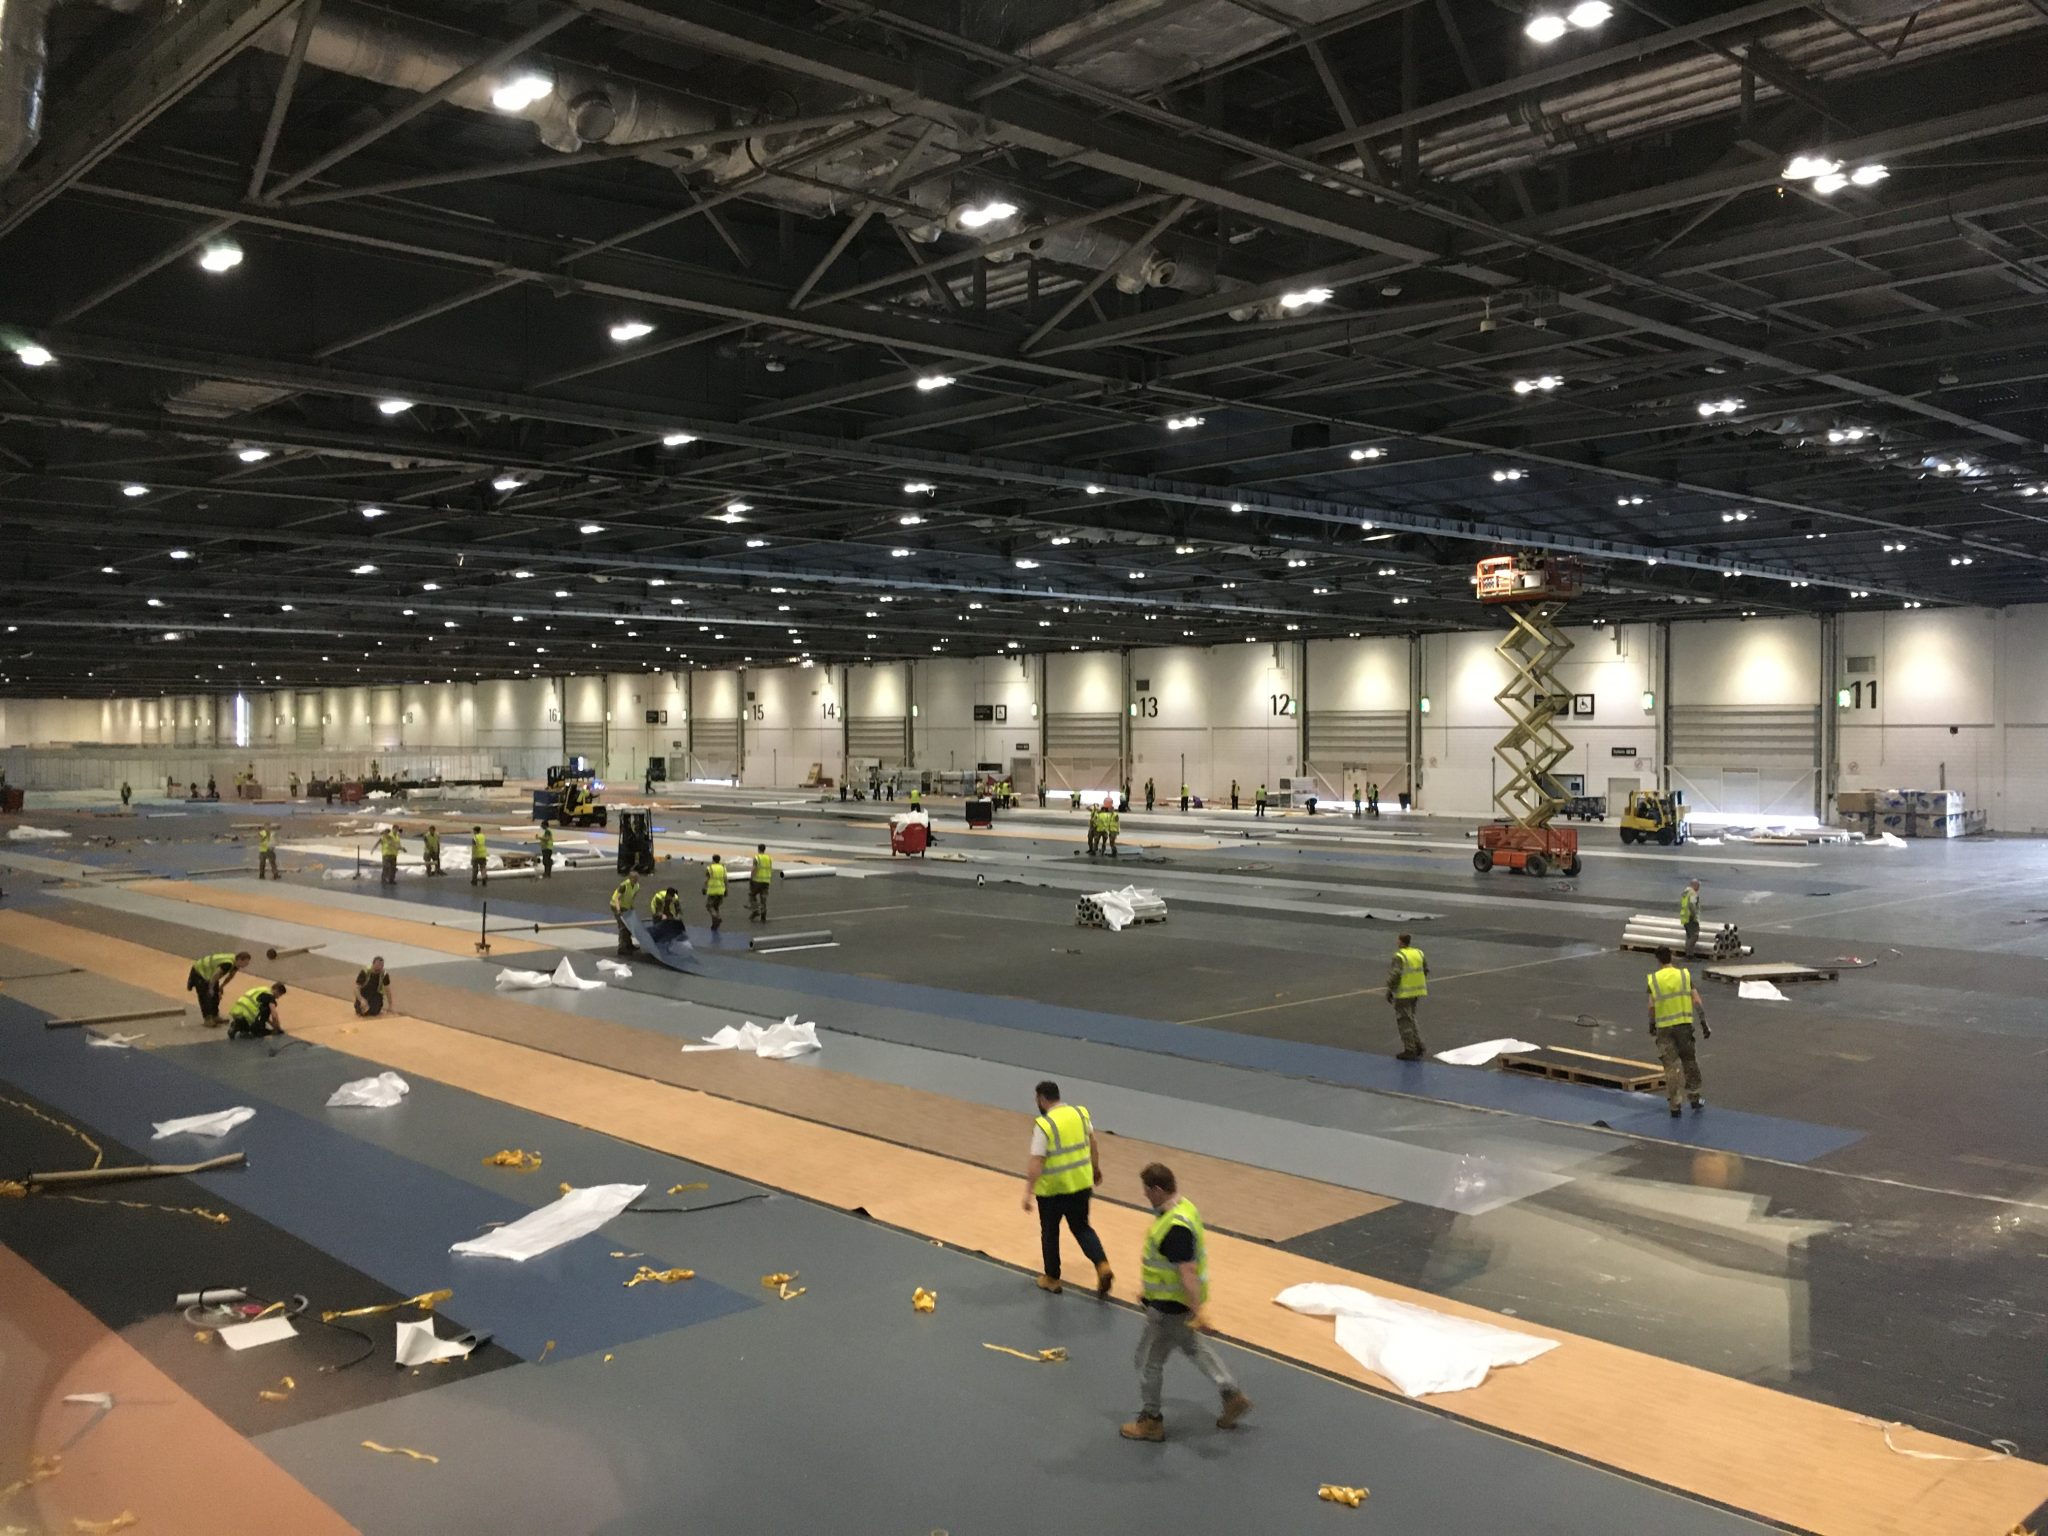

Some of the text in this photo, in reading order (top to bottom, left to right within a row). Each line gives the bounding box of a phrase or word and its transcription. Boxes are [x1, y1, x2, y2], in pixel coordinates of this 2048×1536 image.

[1850, 680, 1877, 710] 11
[752, 704, 764, 720] 15
[822, 703, 835, 719] 14
[1140, 697, 1158, 718] 13
[1271, 694, 1290, 716] 12
[549, 708, 557, 722] 16
